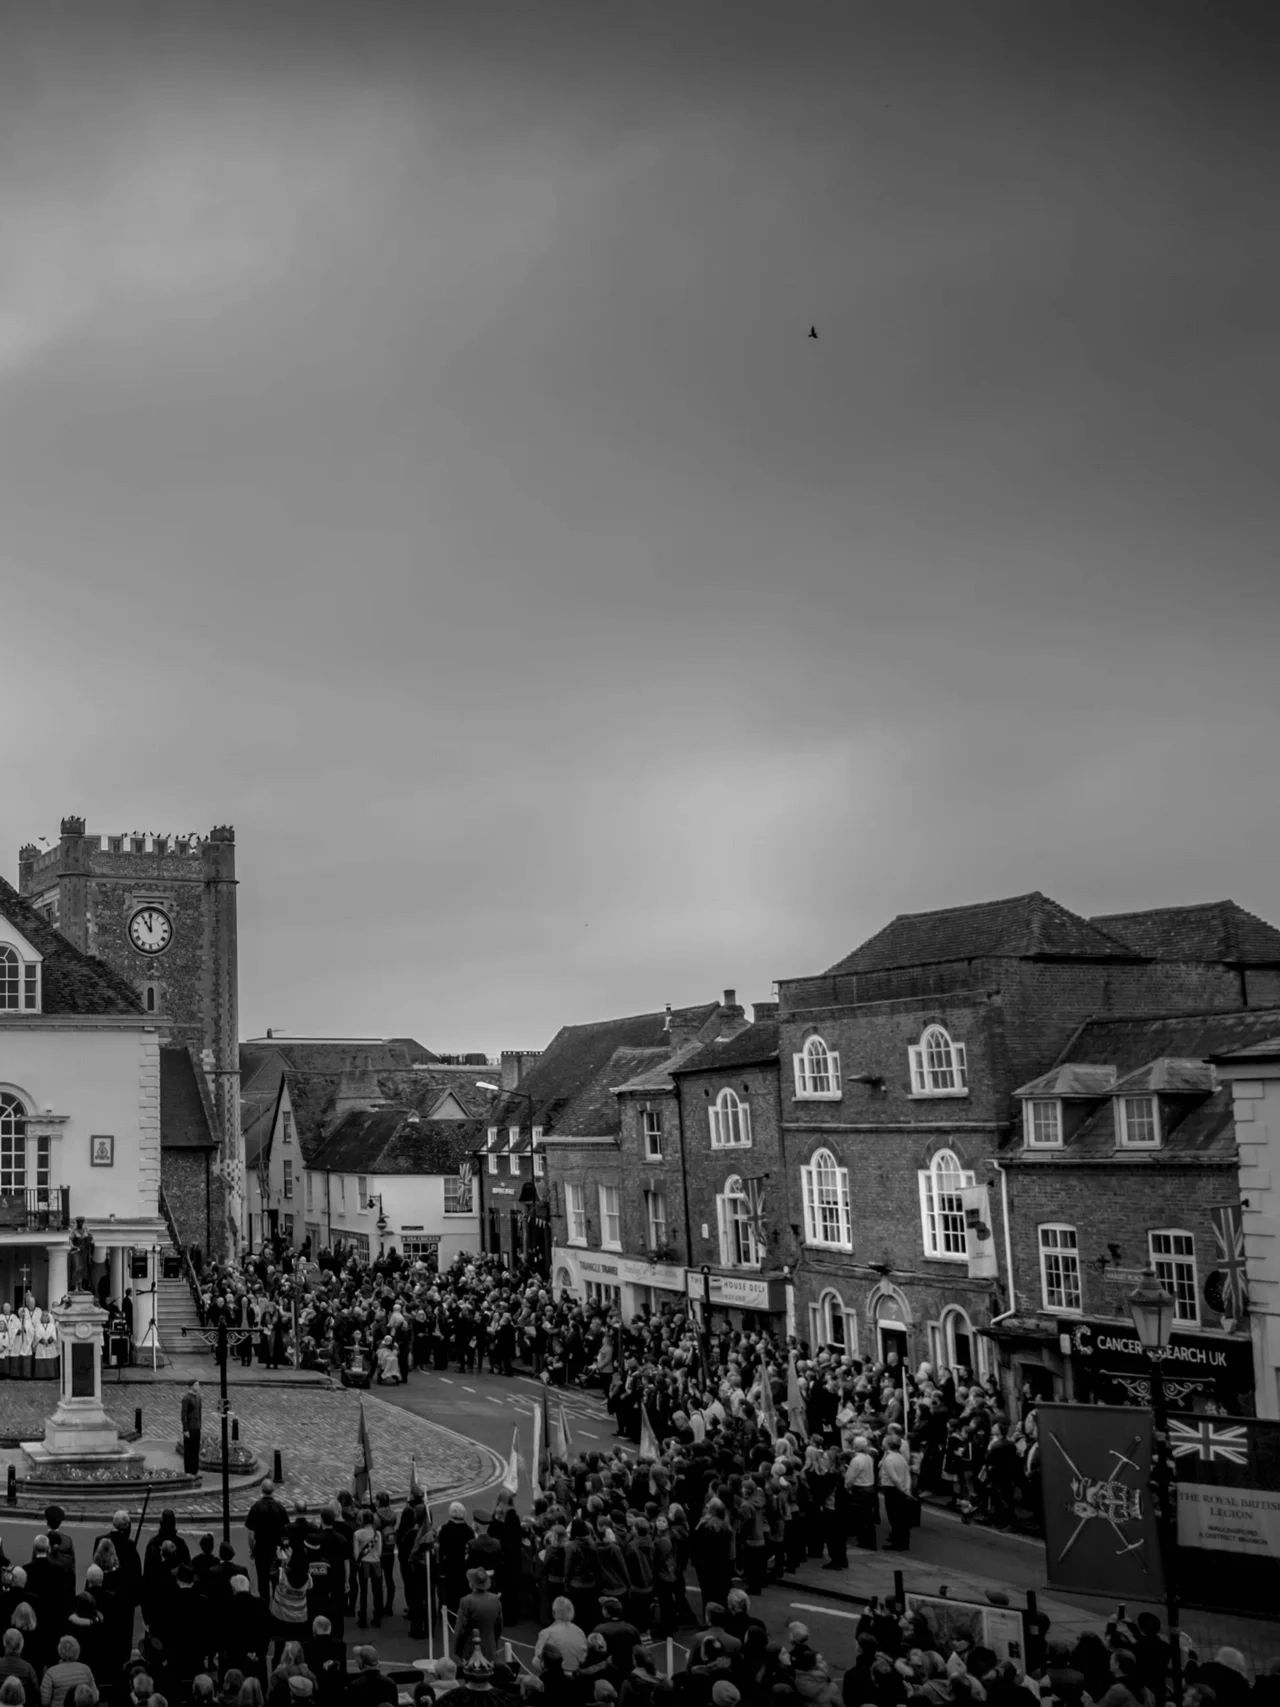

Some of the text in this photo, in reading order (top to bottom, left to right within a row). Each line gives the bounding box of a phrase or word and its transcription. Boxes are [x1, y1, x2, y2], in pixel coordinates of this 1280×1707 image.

[1096, 1335, 1143, 1355] CANCER
[1208, 1351, 1228, 1367] UK
[1179, 1492, 1280, 1511] THE ROYAL BRITIS
[1209, 1506, 1254, 1520] LEGION
